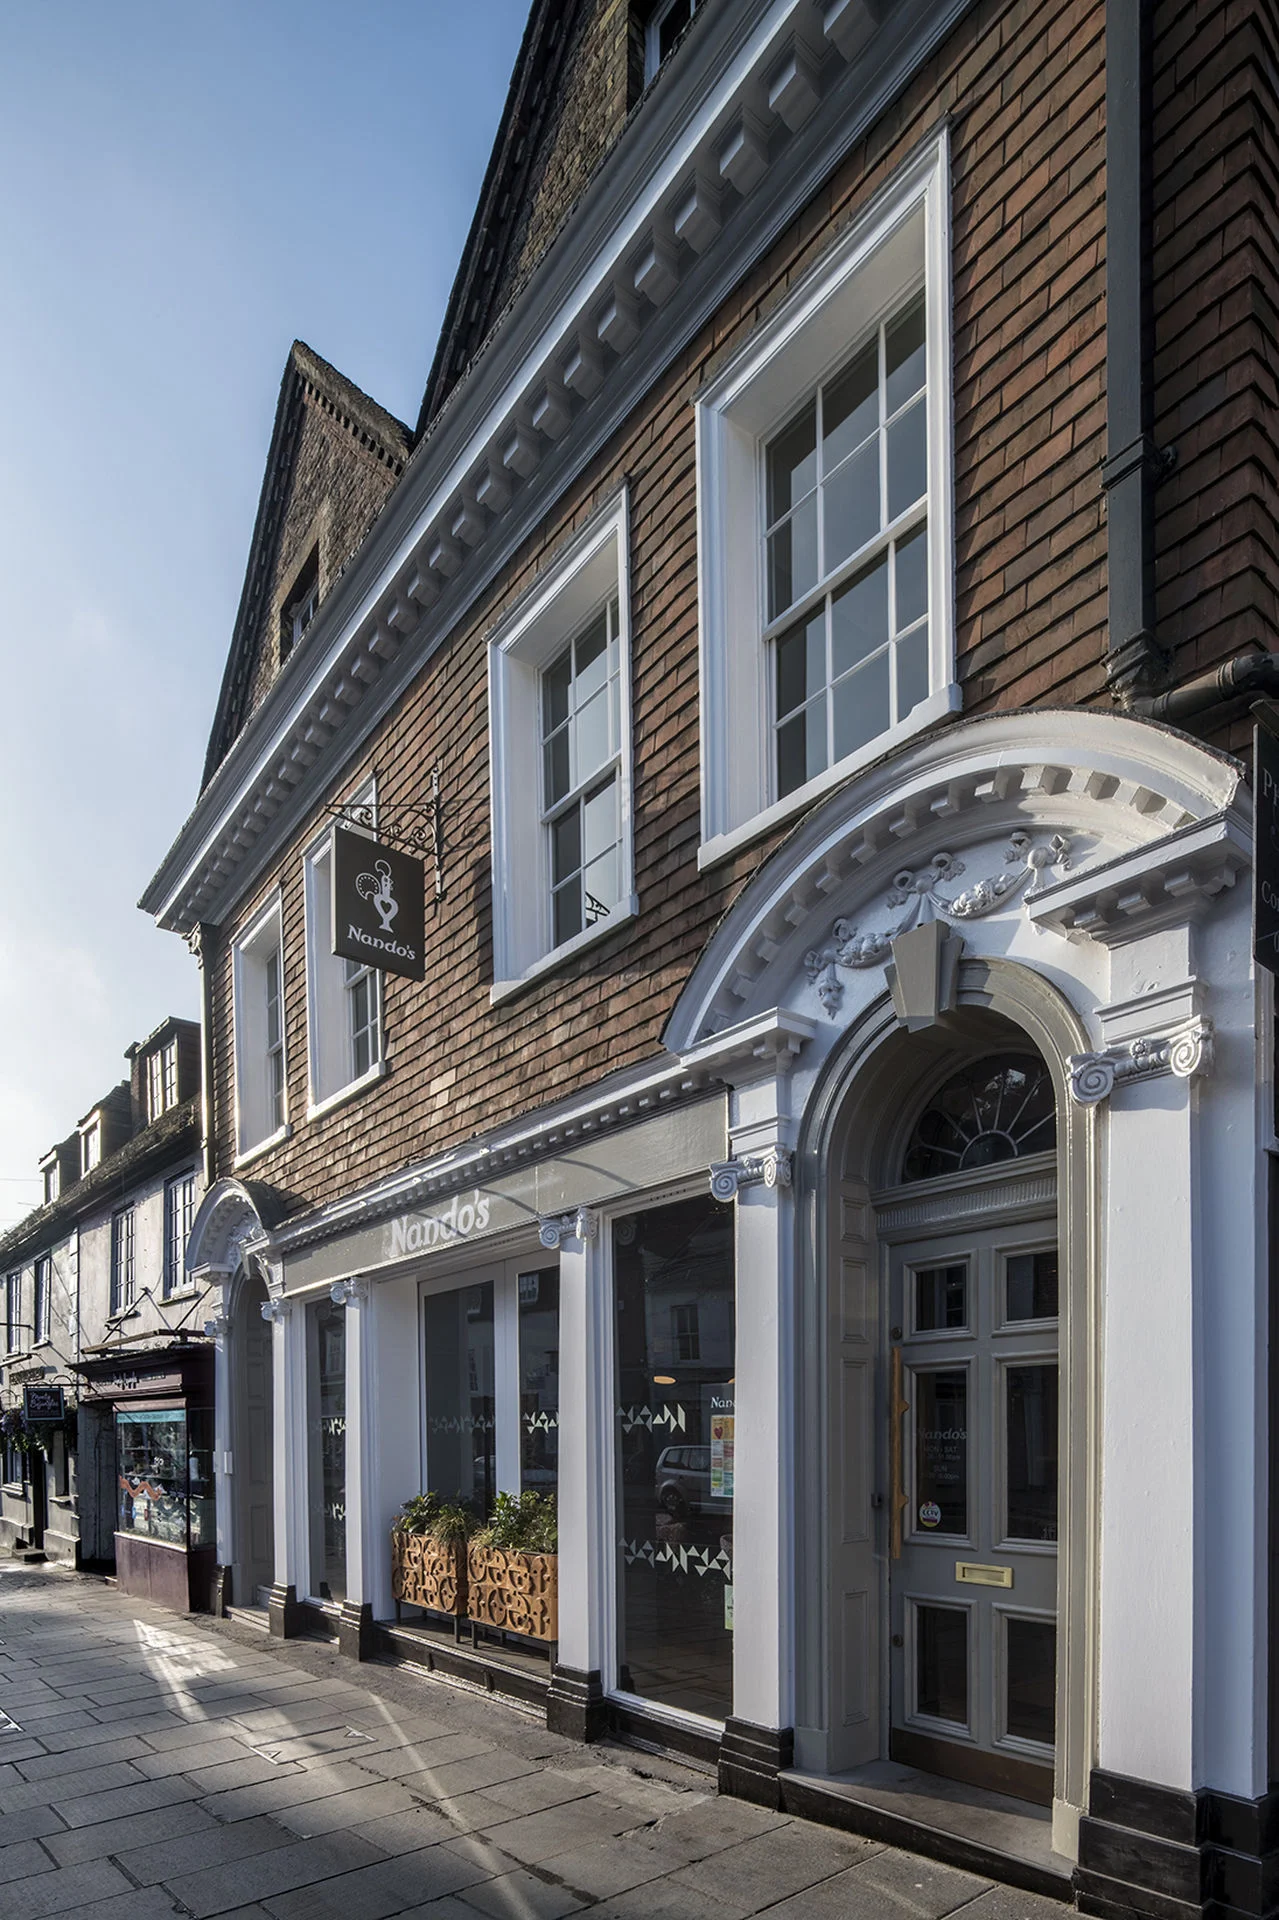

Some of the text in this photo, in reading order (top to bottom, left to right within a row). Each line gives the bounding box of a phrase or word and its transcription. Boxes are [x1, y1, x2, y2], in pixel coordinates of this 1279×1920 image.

[347, 924, 416, 960] Nando's
[389, 1188, 490, 1258] Nando's
[711, 1396, 736, 1409] Nan
